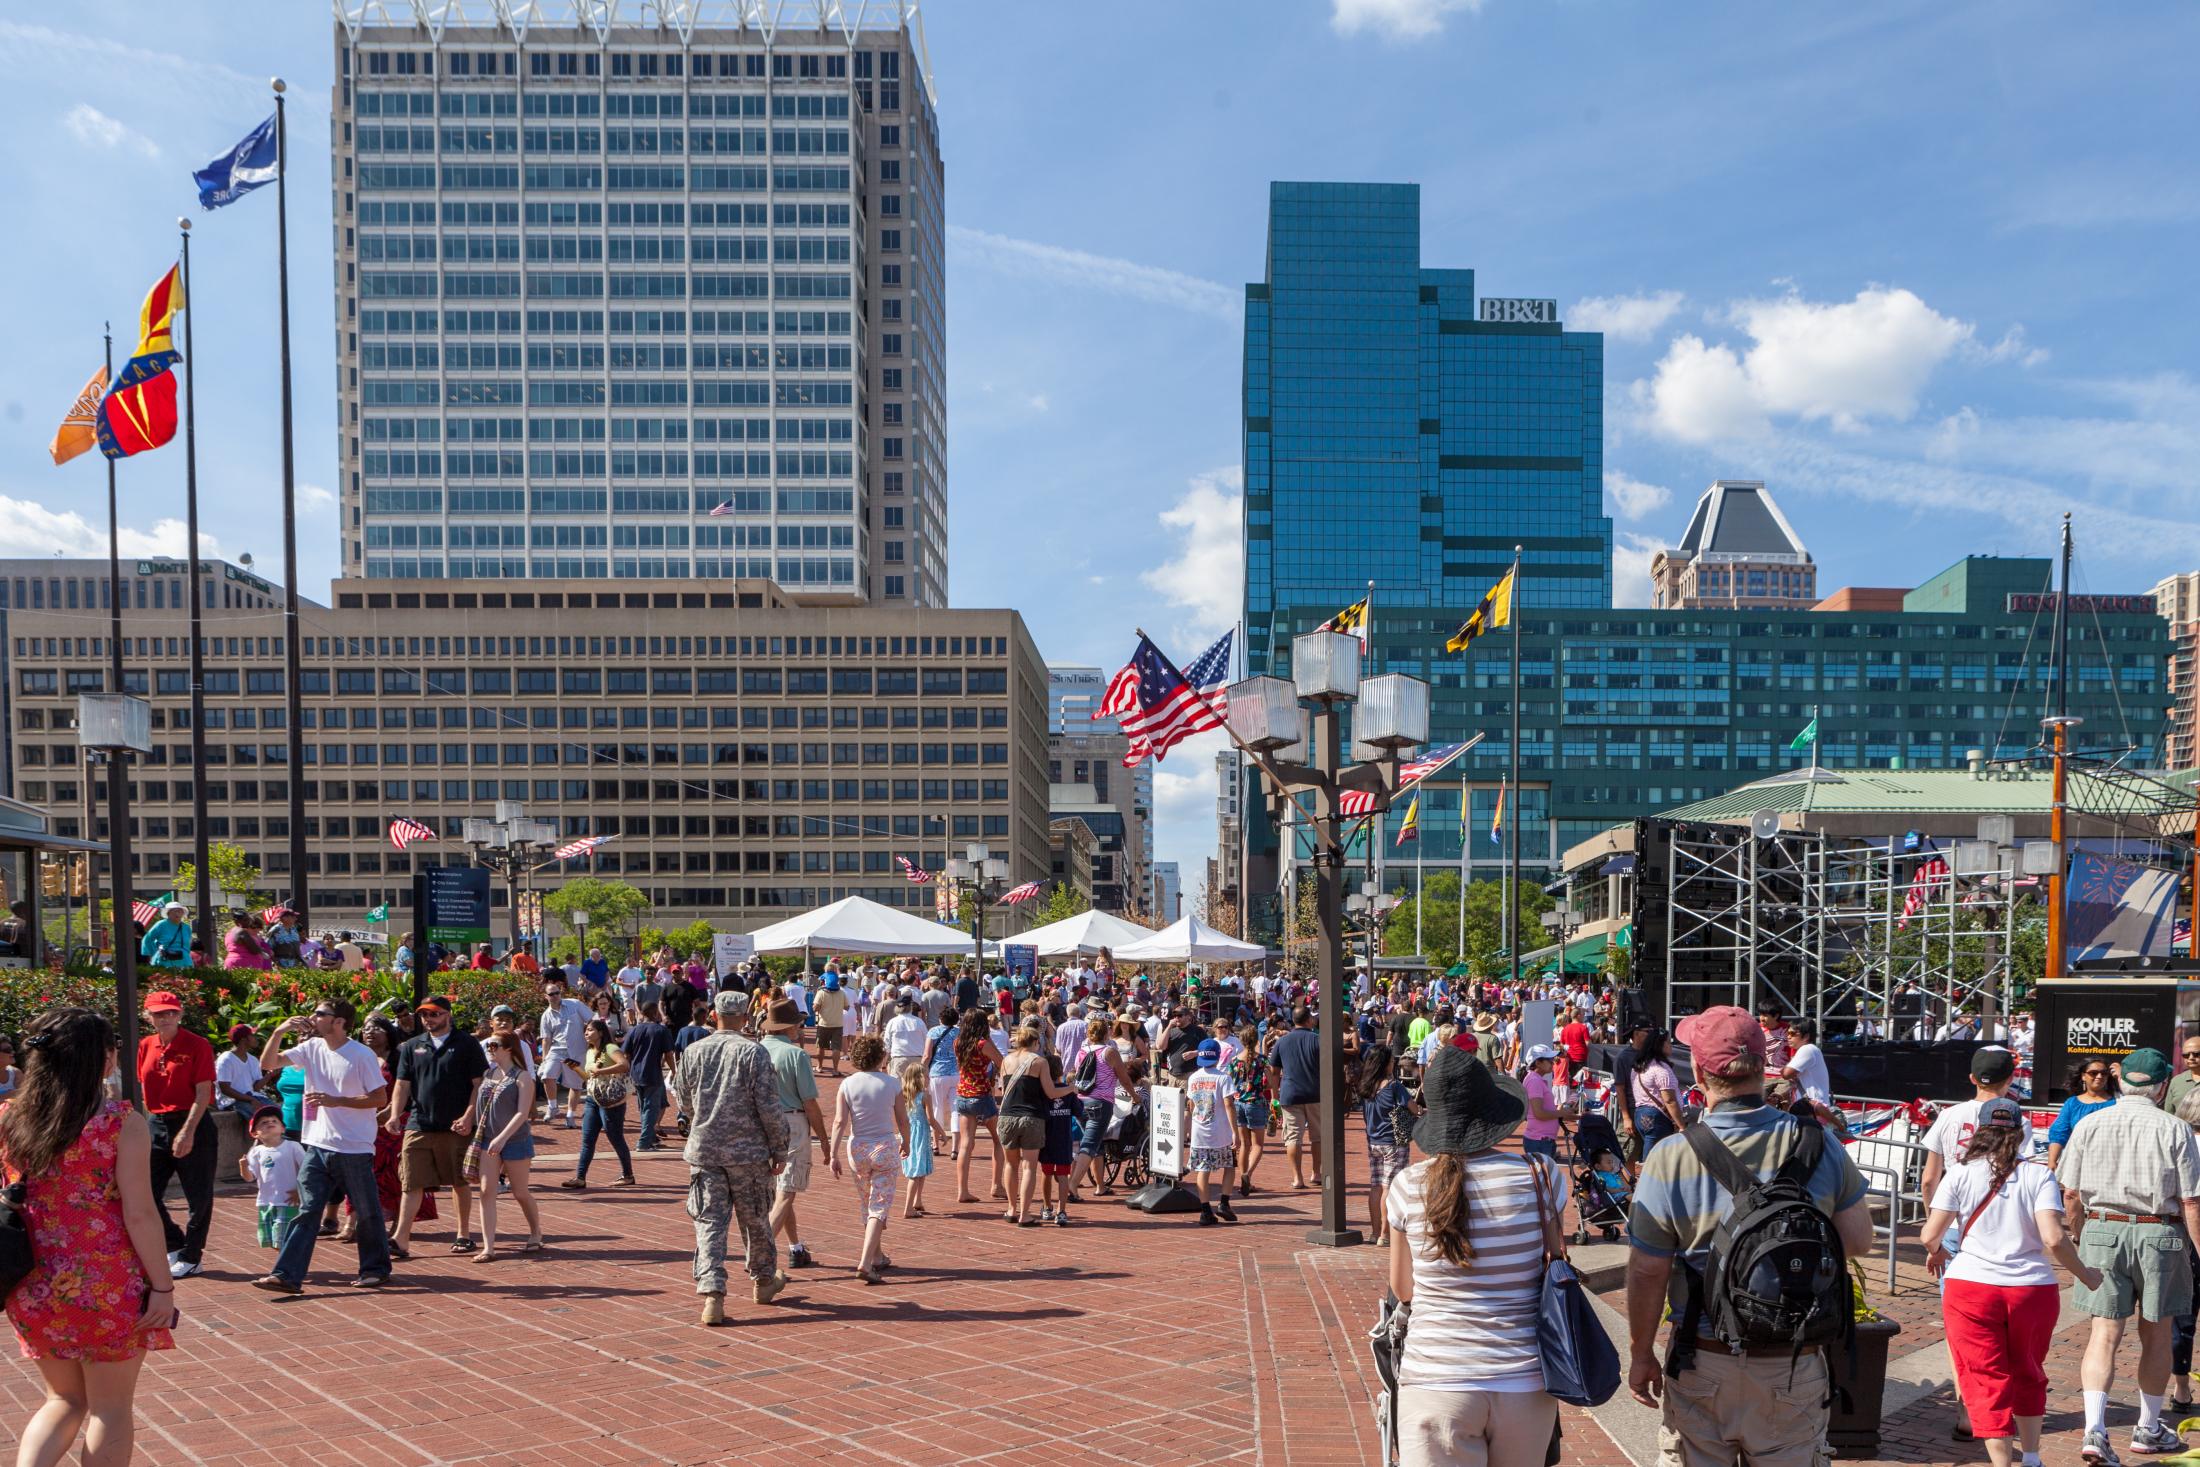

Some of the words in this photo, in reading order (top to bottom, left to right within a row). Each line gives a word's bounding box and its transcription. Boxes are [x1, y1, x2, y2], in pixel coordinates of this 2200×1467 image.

[1481, 299, 1555, 323] BB&T
[335, 931, 369, 941] ZNE
[2067, 1031, 2137, 1047] RENTAL
[1161, 1112, 1171, 1121] FOOD
[1162, 1120, 1170, 1128] AND
[1157, 1126, 1176, 1137] BEVERAGE
